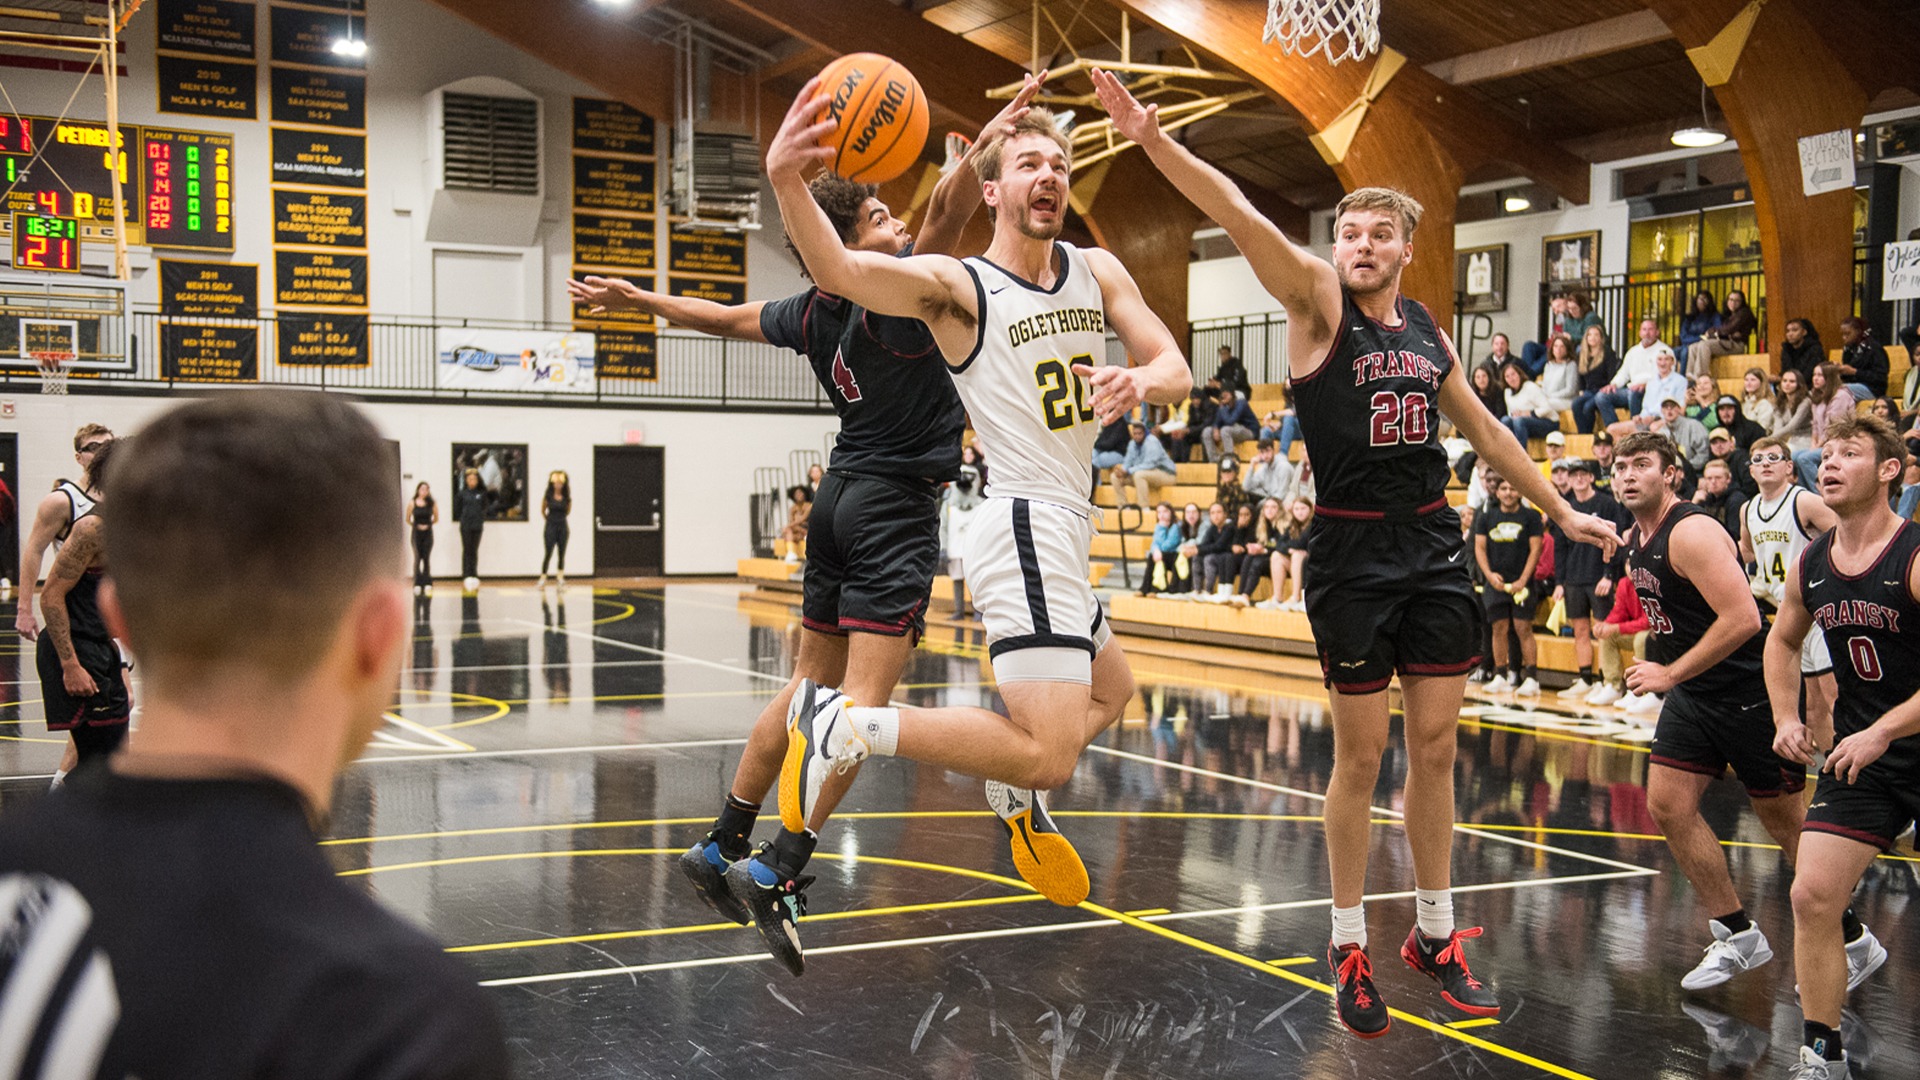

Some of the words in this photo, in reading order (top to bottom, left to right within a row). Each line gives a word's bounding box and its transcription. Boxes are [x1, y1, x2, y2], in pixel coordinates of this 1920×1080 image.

[852, 80, 906, 154] Wilson
[56, 125, 124, 148] PETRELS
[186, 145, 199, 162] 0
[215, 147, 229, 165] 2
[1801, 147, 1850, 168] SECTION
[104, 150, 128, 184] 4
[186, 163, 200, 179] 0
[215, 165, 229, 182] 0
[7, 190, 36, 200] TIME
[187, 180, 200, 197] 0
[215, 182, 229, 199] 0
[38, 189, 59, 215] 4
[73, 192, 93, 218] 0
[149, 194, 171, 211] 20
[187, 197, 200, 214] 0
[216, 199, 230, 216] 0
[26, 217, 75, 239] 16:21
[149, 211, 171, 229] 22
[187, 214, 200, 231] 0
[216, 215, 230, 233] 2
[25, 235, 70, 268] 21
[321, 267, 351, 279] TENNIS
[212, 282, 233, 291] GOLF
[312, 280, 353, 291] REGULAR
[198, 293, 244, 304] CHAMPIONS
[1008, 308, 1104, 348] OGLETHORPE
[1353, 350, 1442, 390] TRANSY
[1034, 352, 1094, 432] 20
[1370, 391, 1429, 447] 20
[1813, 600, 1900, 633] TRANSY
[1847, 636, 1883, 682] 0
